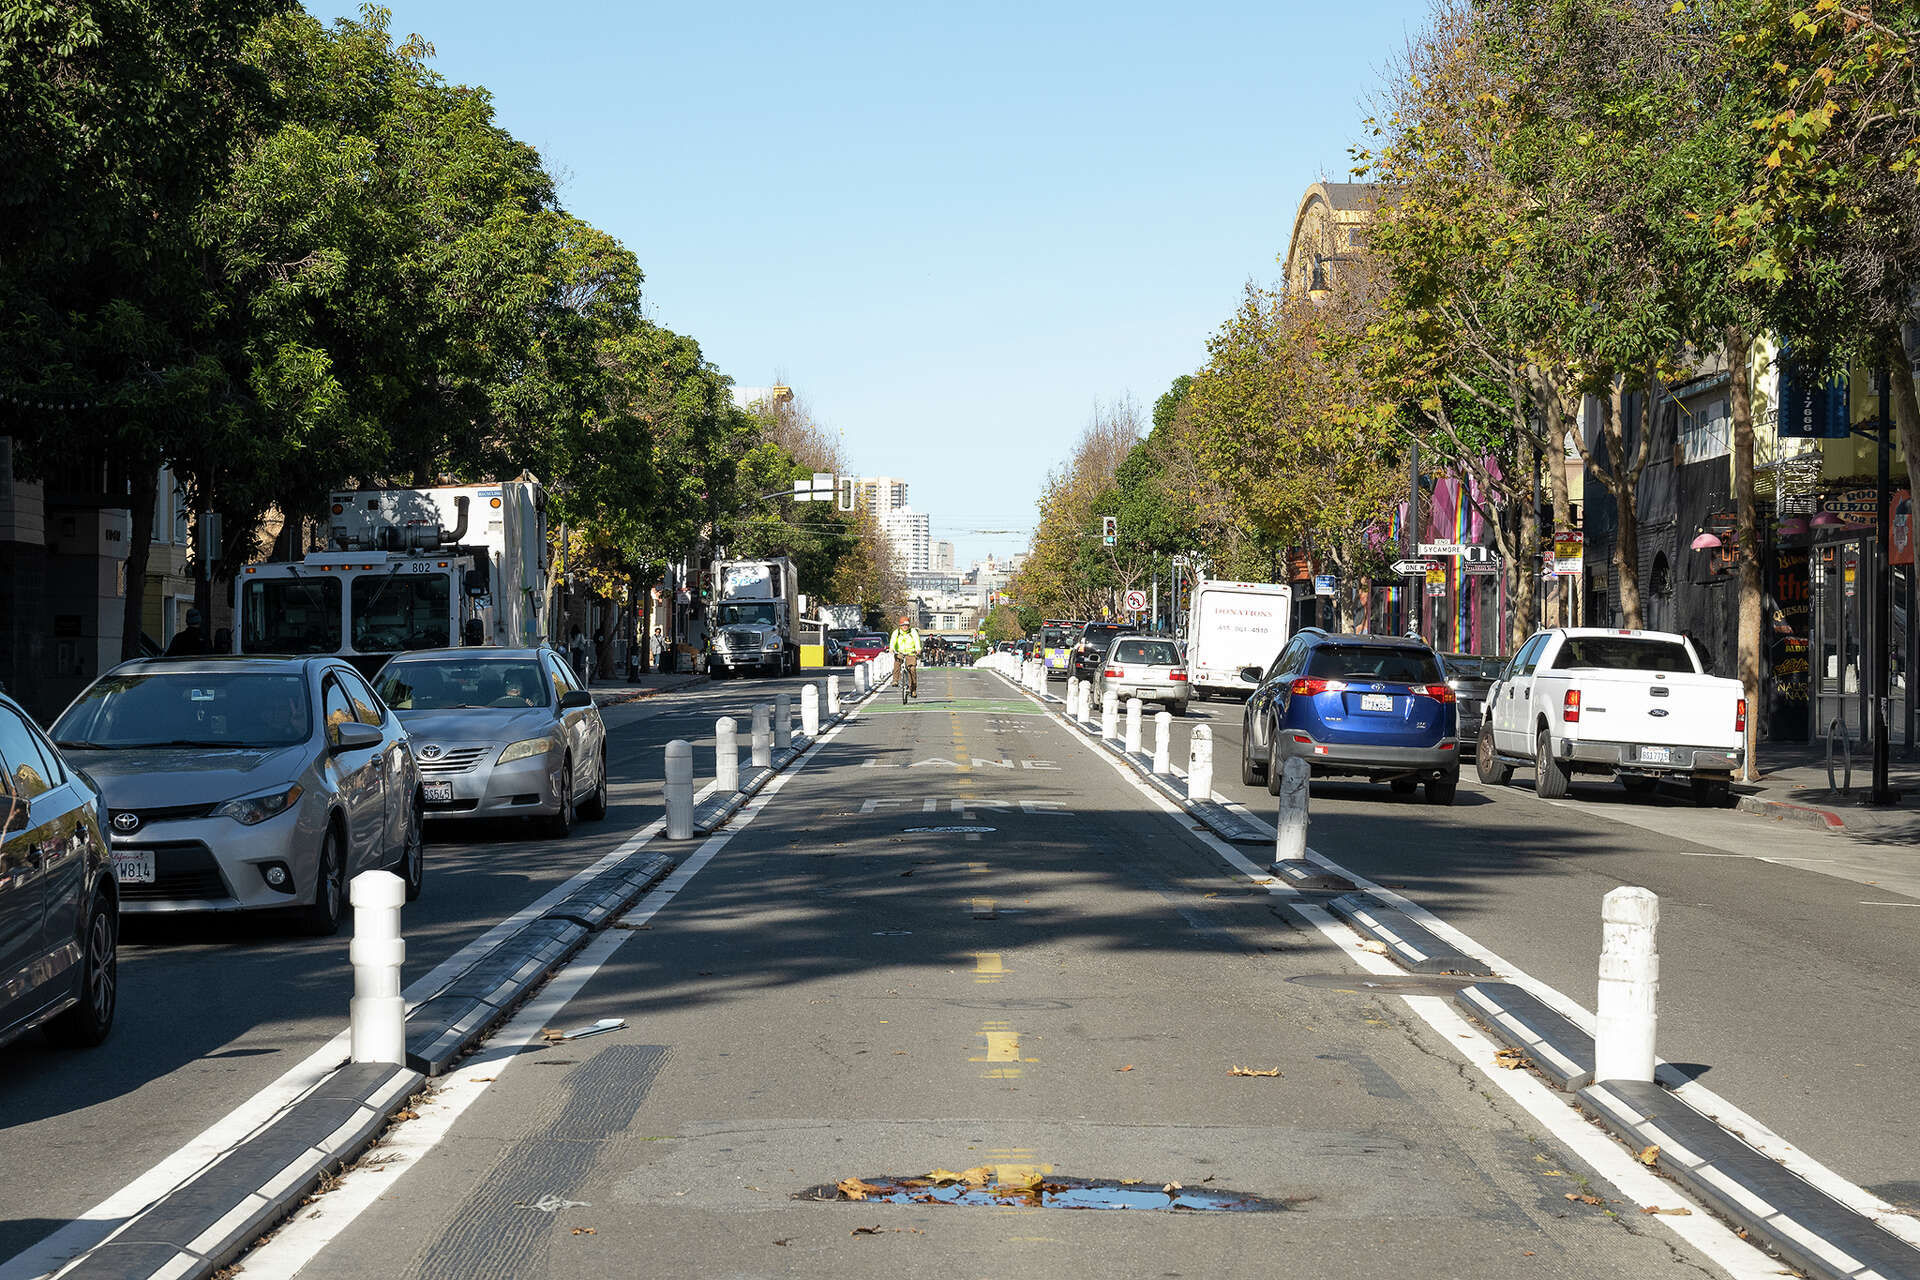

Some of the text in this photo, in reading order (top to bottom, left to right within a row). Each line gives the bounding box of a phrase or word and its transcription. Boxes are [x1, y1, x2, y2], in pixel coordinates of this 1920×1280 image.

[412, 562, 431, 573] 802
[1215, 607, 1273, 617] DONATIONS
[860, 757, 1064, 770] LANE
[859, 798, 1075, 816] FIRE
[115, 862, 150, 878] W814
